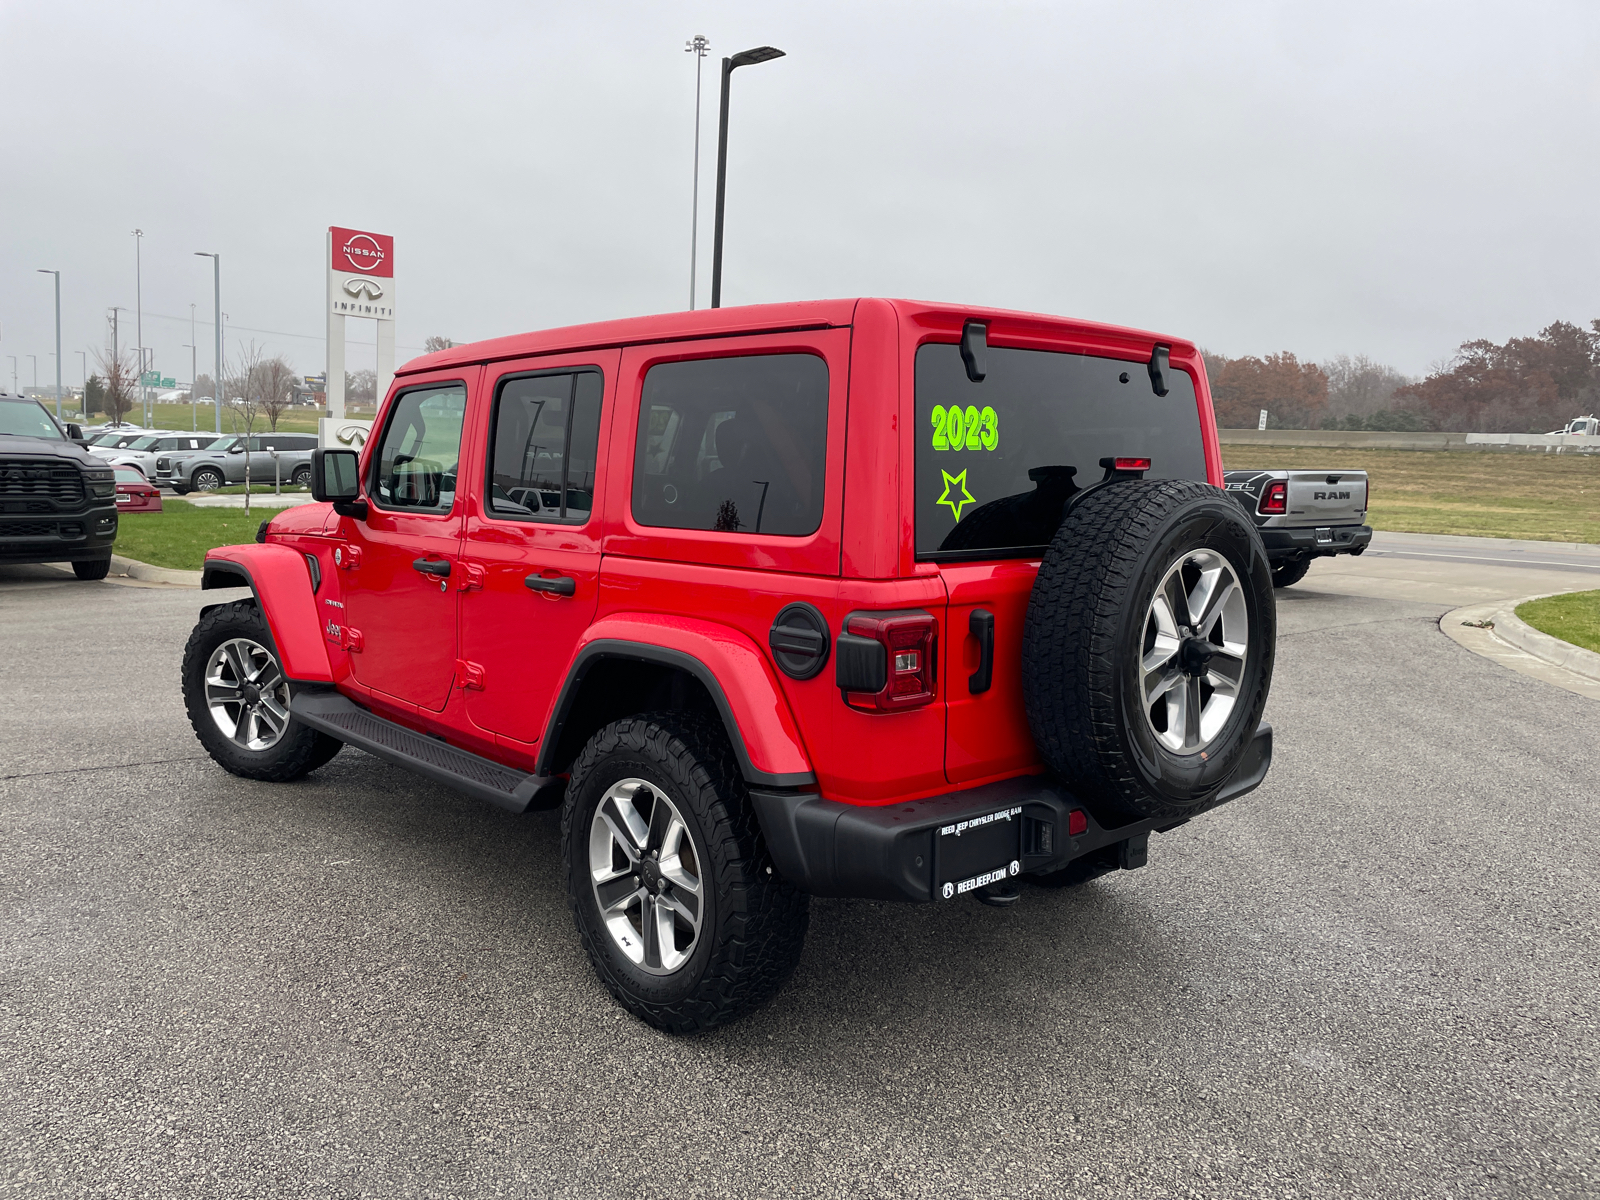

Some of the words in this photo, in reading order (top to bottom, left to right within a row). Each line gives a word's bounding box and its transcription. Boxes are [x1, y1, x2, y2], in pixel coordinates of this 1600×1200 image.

[343, 245, 385, 259] NISSAN
[334, 301, 392, 316] INFINITI
[931, 404, 999, 451] 2023
[0, 470, 49, 479] AM
[1313, 491, 1351, 500] RAM
[941, 825, 955, 836] REED
[956, 821, 969, 831] JEEP
[968, 814, 994, 828] CHRYSLER
[994, 810, 1010, 821] DODGE
[1010, 806, 1022, 816] RAM
[957, 868, 1007, 894] REEDJEEP.COM
